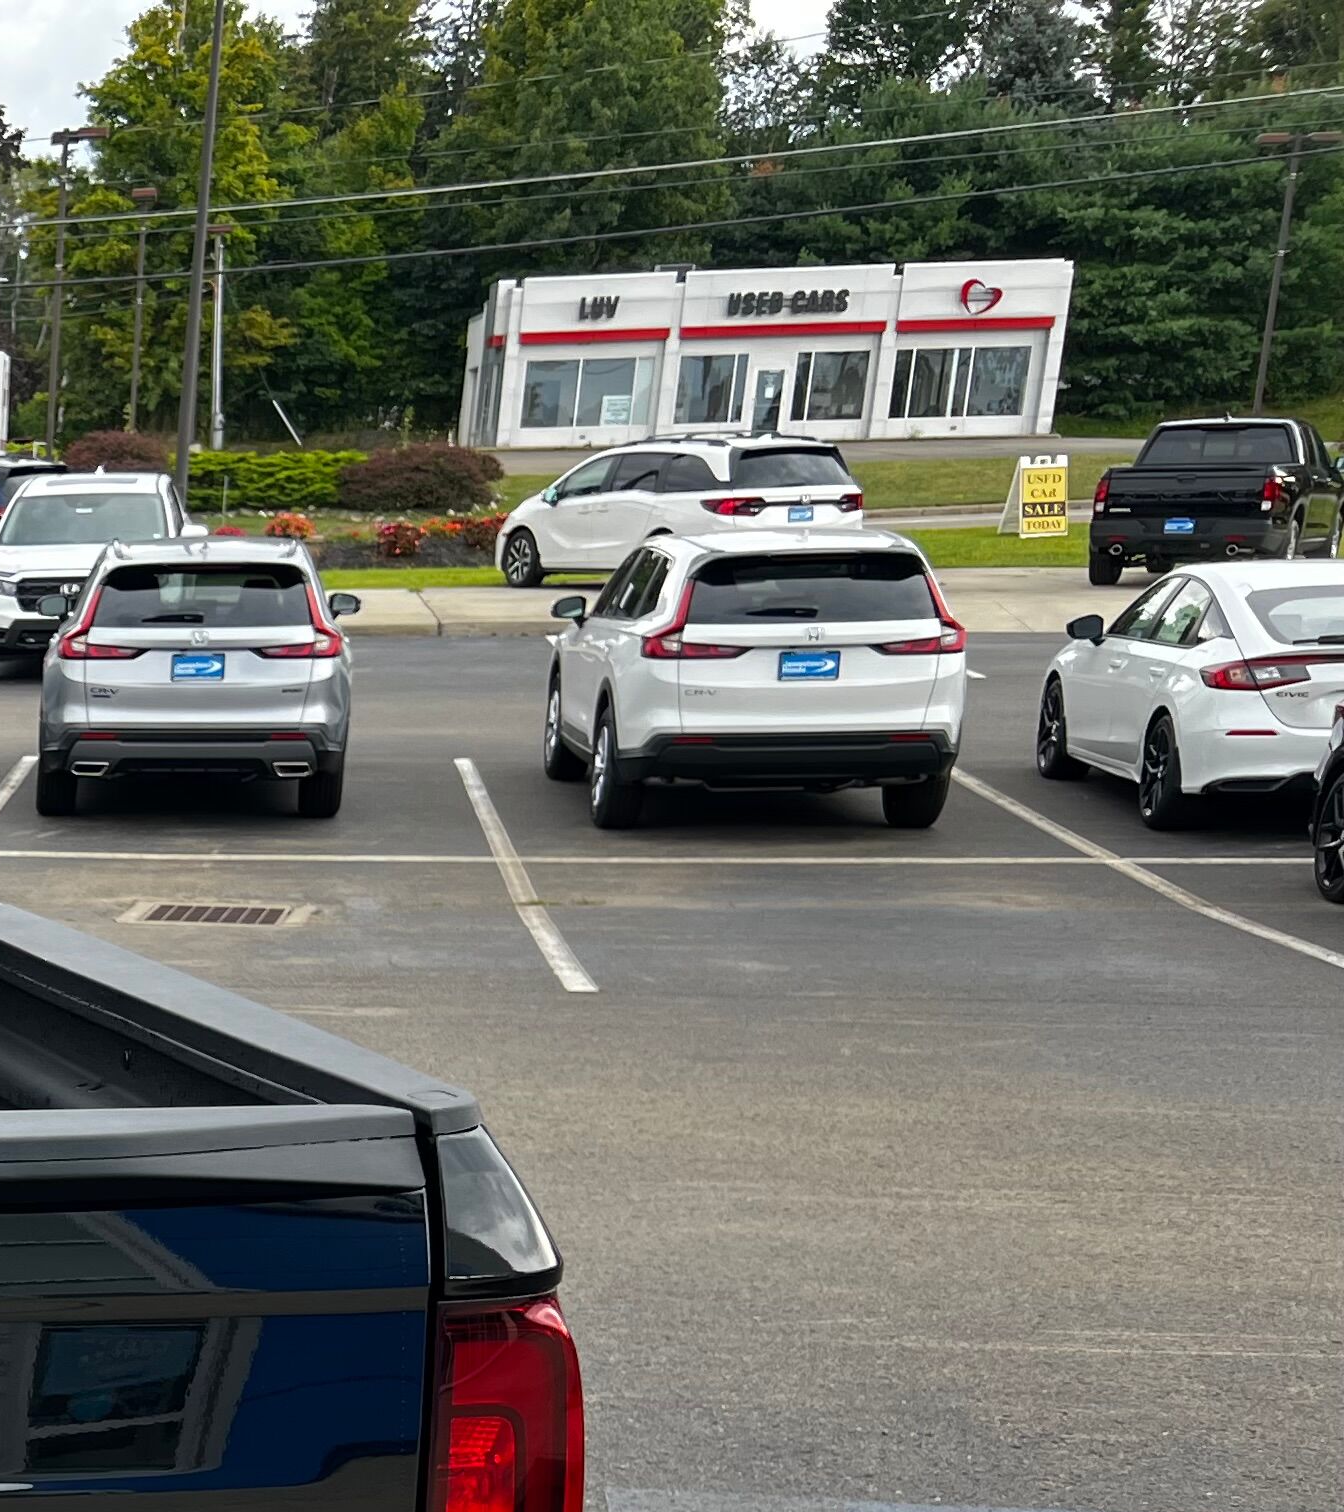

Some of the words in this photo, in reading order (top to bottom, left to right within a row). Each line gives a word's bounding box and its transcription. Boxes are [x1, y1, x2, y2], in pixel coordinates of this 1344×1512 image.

[578, 295, 620, 320] LUV
[728, 291, 783, 316] USED
[791, 289, 849, 314] CARS
[1027, 473, 1062, 485] USED
[1030, 488, 1057, 499] CAR
[1024, 503, 1064, 515] SALE
[1026, 519, 1063, 531] TODAY
